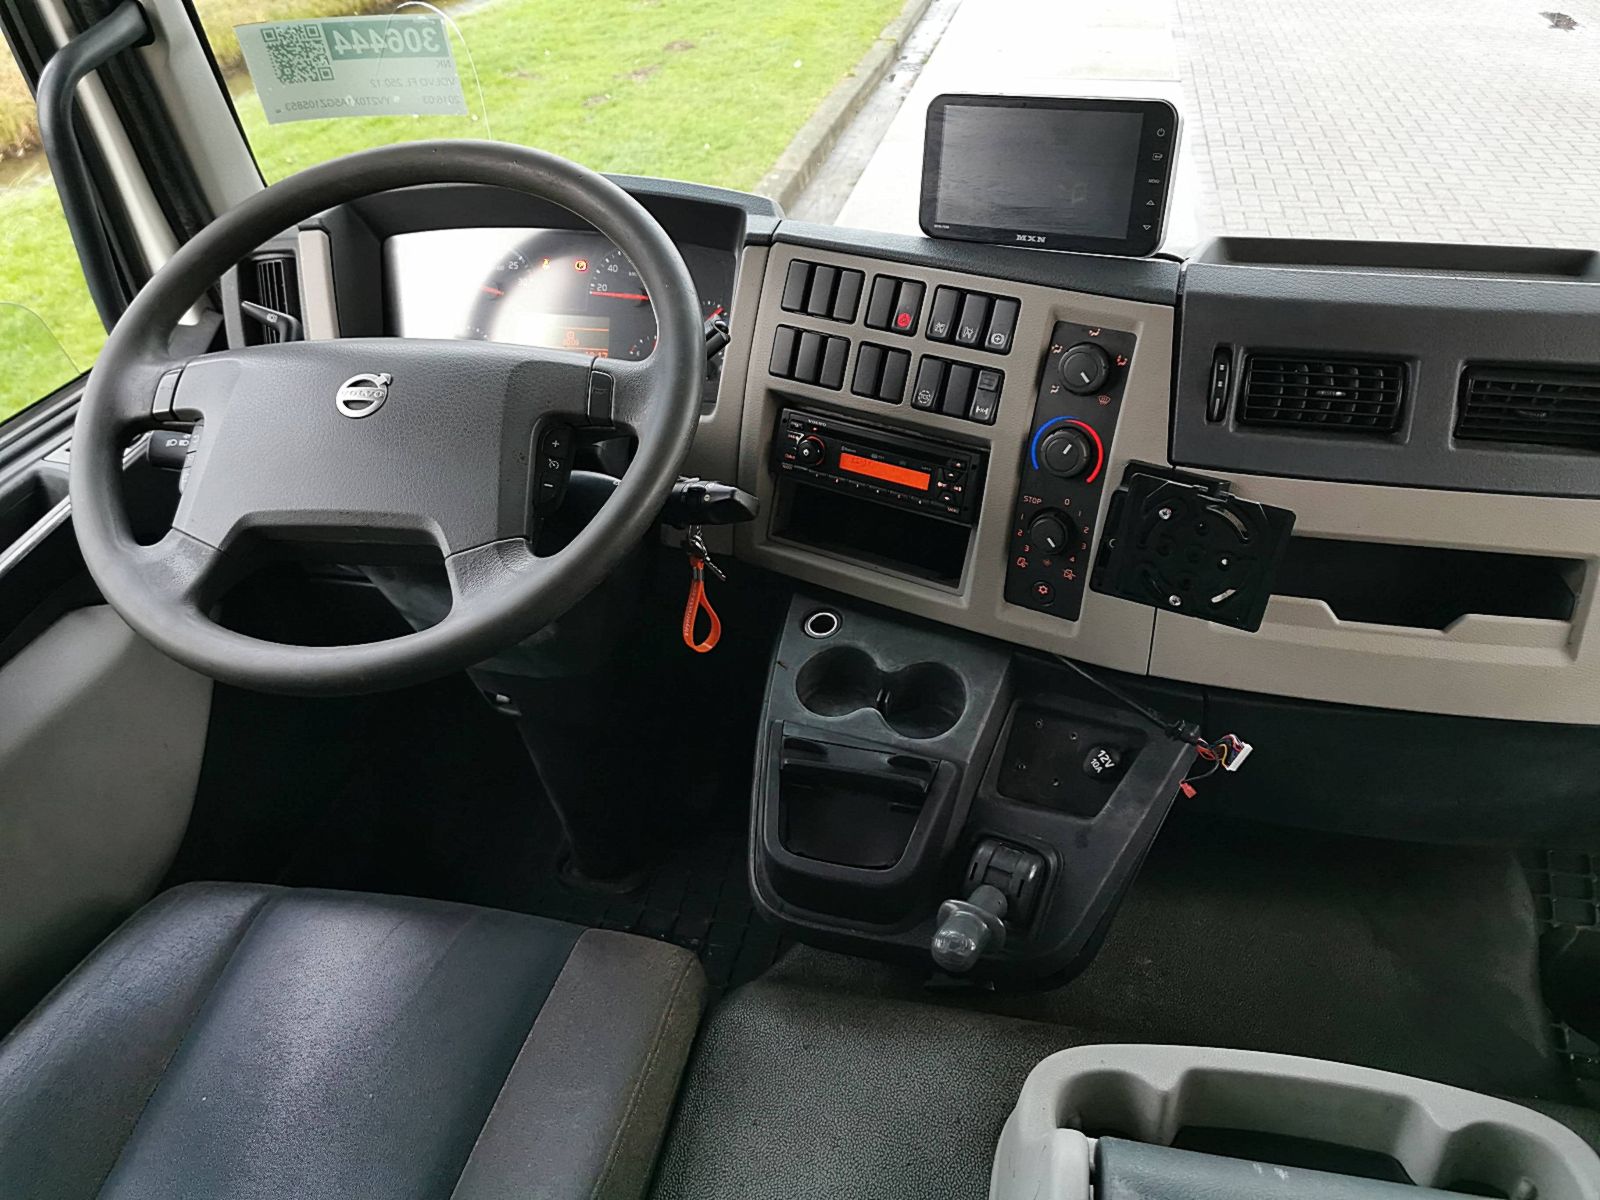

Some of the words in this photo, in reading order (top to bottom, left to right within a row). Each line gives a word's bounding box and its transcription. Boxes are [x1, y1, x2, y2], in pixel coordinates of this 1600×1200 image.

[1016, 234, 1046, 243] MXN
[509, 261, 519, 270] 25
[607, 263, 618, 273] 40
[597, 283, 607, 292] 20
[1023, 495, 1042, 505] STOP
[1098, 750, 1115, 768] 12V
[1091, 758, 1103, 774] 10A
